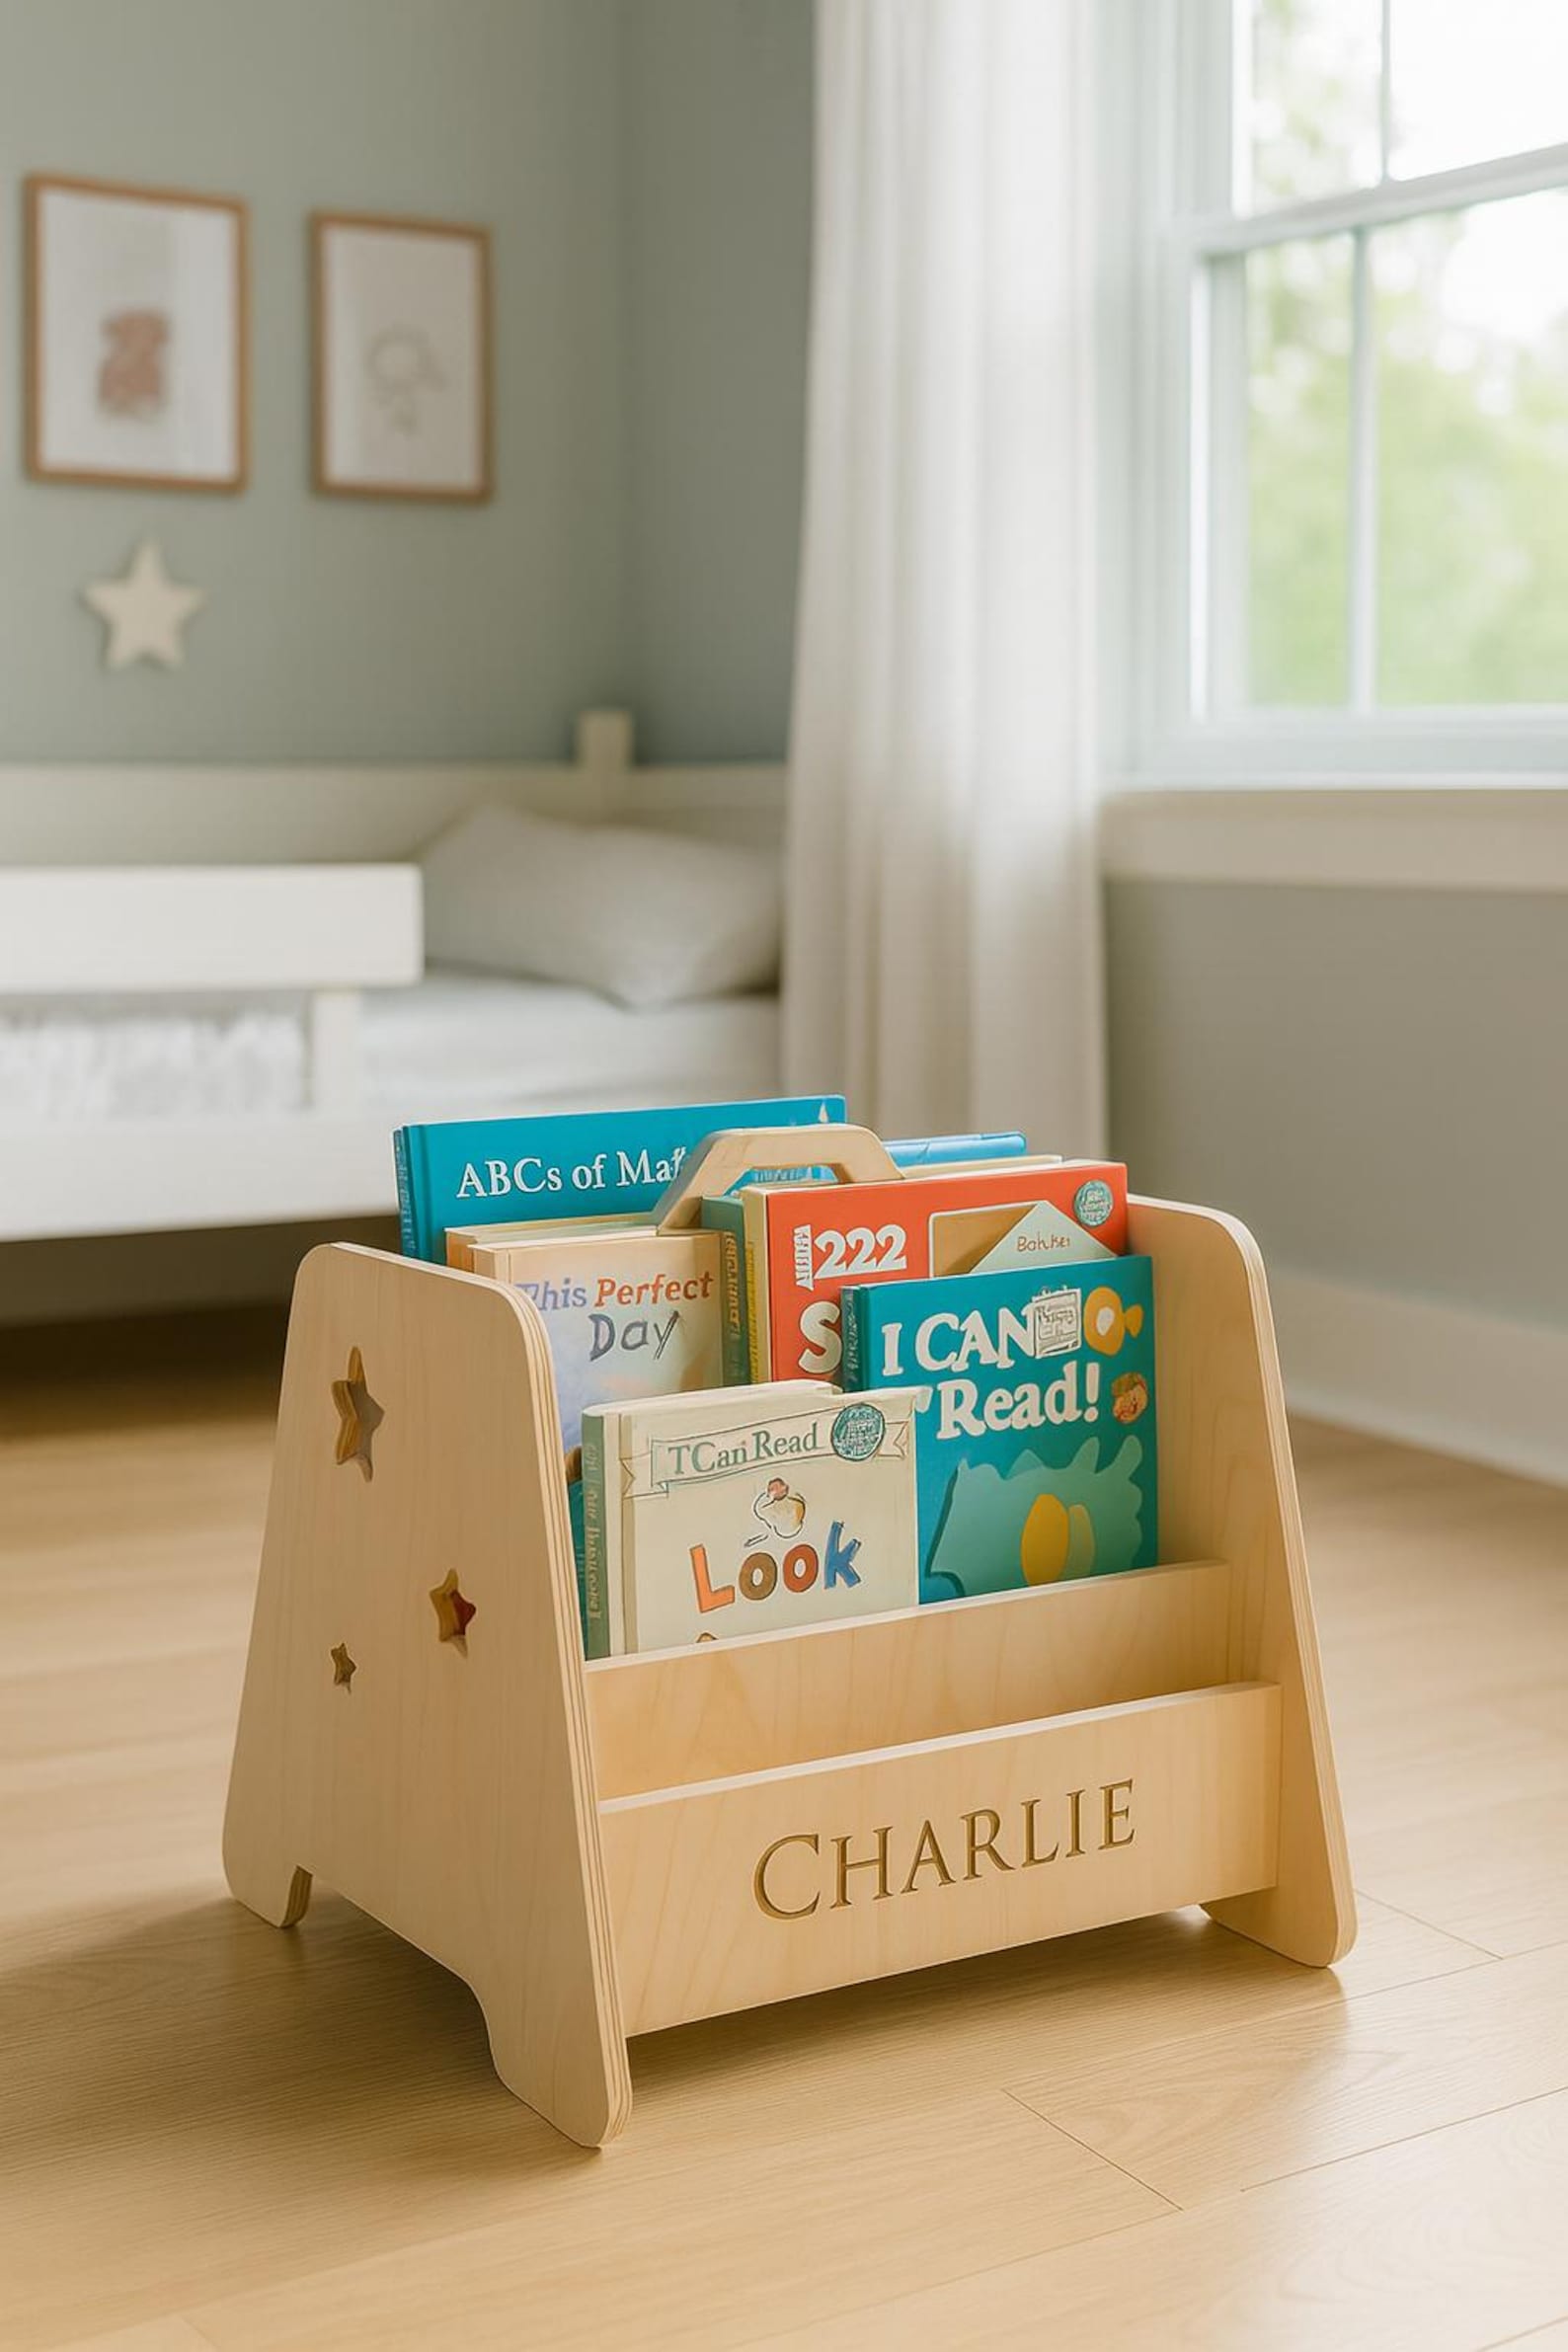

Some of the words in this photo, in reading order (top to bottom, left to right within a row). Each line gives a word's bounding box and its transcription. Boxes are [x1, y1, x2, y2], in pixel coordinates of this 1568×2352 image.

[456, 1157, 563, 1199] ABCs
[572, 1153, 607, 1190] of
[814, 1223, 906, 1280] 222
[593, 1271, 715, 1308] Perfect
[588, 1310, 681, 1362] Day
[881, 1322, 903, 1376] I
[914, 1306, 1037, 1372] CAN
[751, 1422, 821, 1460] Read
[752, 1778, 1137, 1921] CHARLIE
